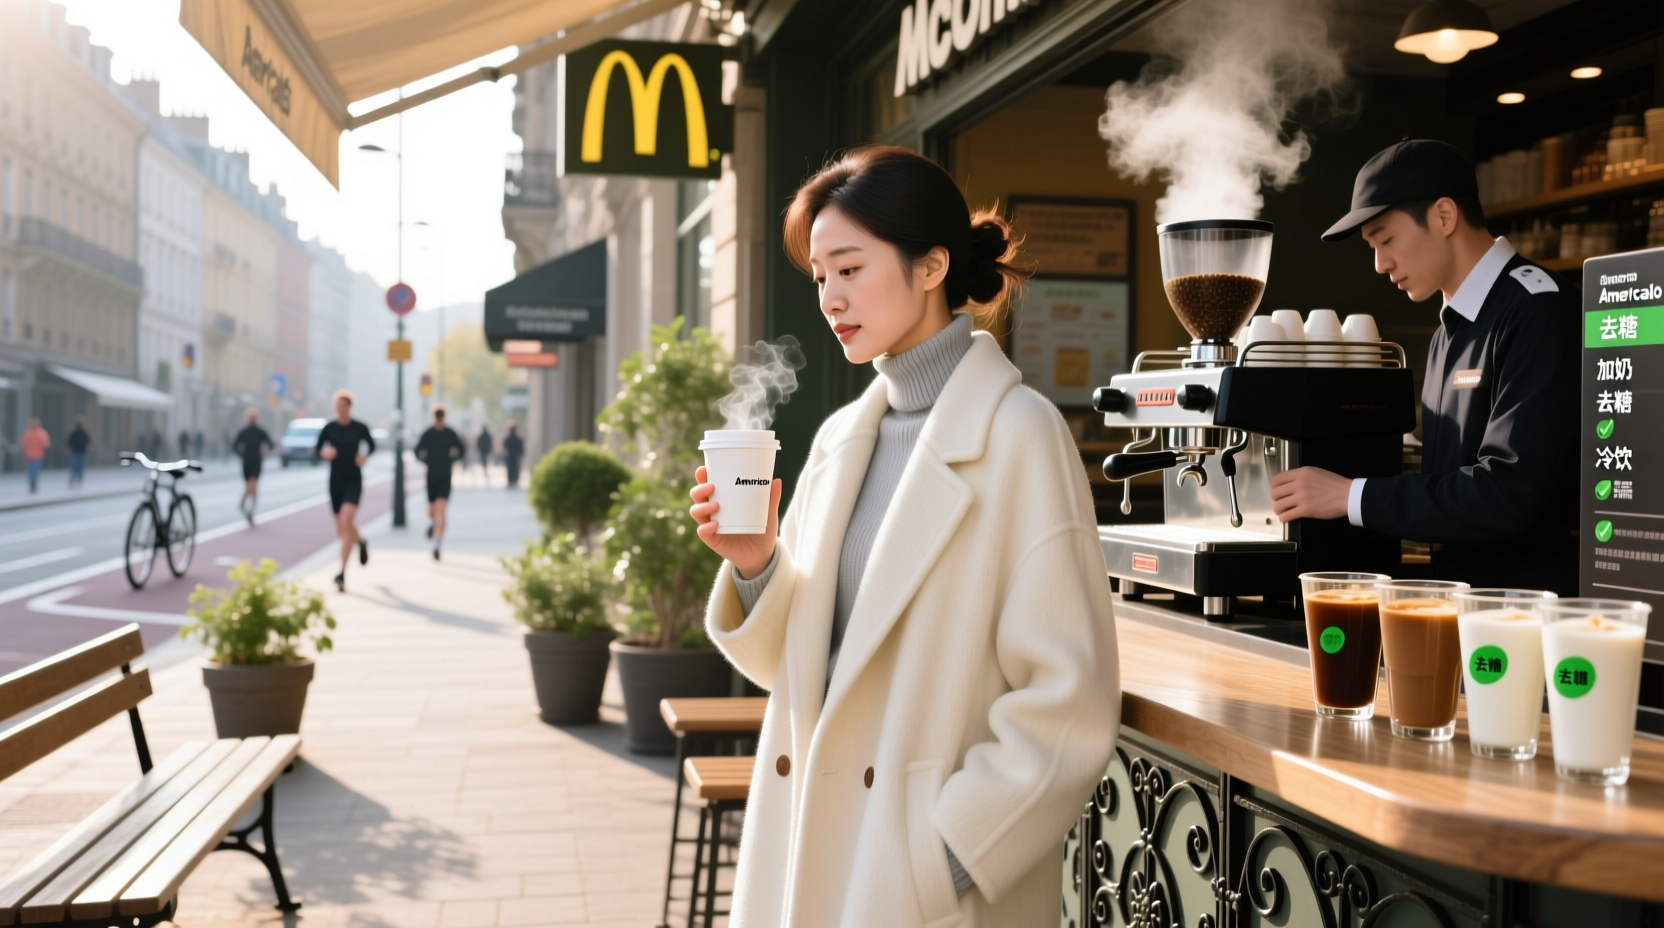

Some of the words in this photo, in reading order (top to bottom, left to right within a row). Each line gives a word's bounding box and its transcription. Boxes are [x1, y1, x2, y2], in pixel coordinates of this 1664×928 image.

[581, 49, 709, 168] M
[1599, 313, 1638, 340] 去糖
[1597, 357, 1633, 381] 加奶
[1596, 389, 1633, 414] 去糖
[1595, 445, 1633, 471] 冷饮
